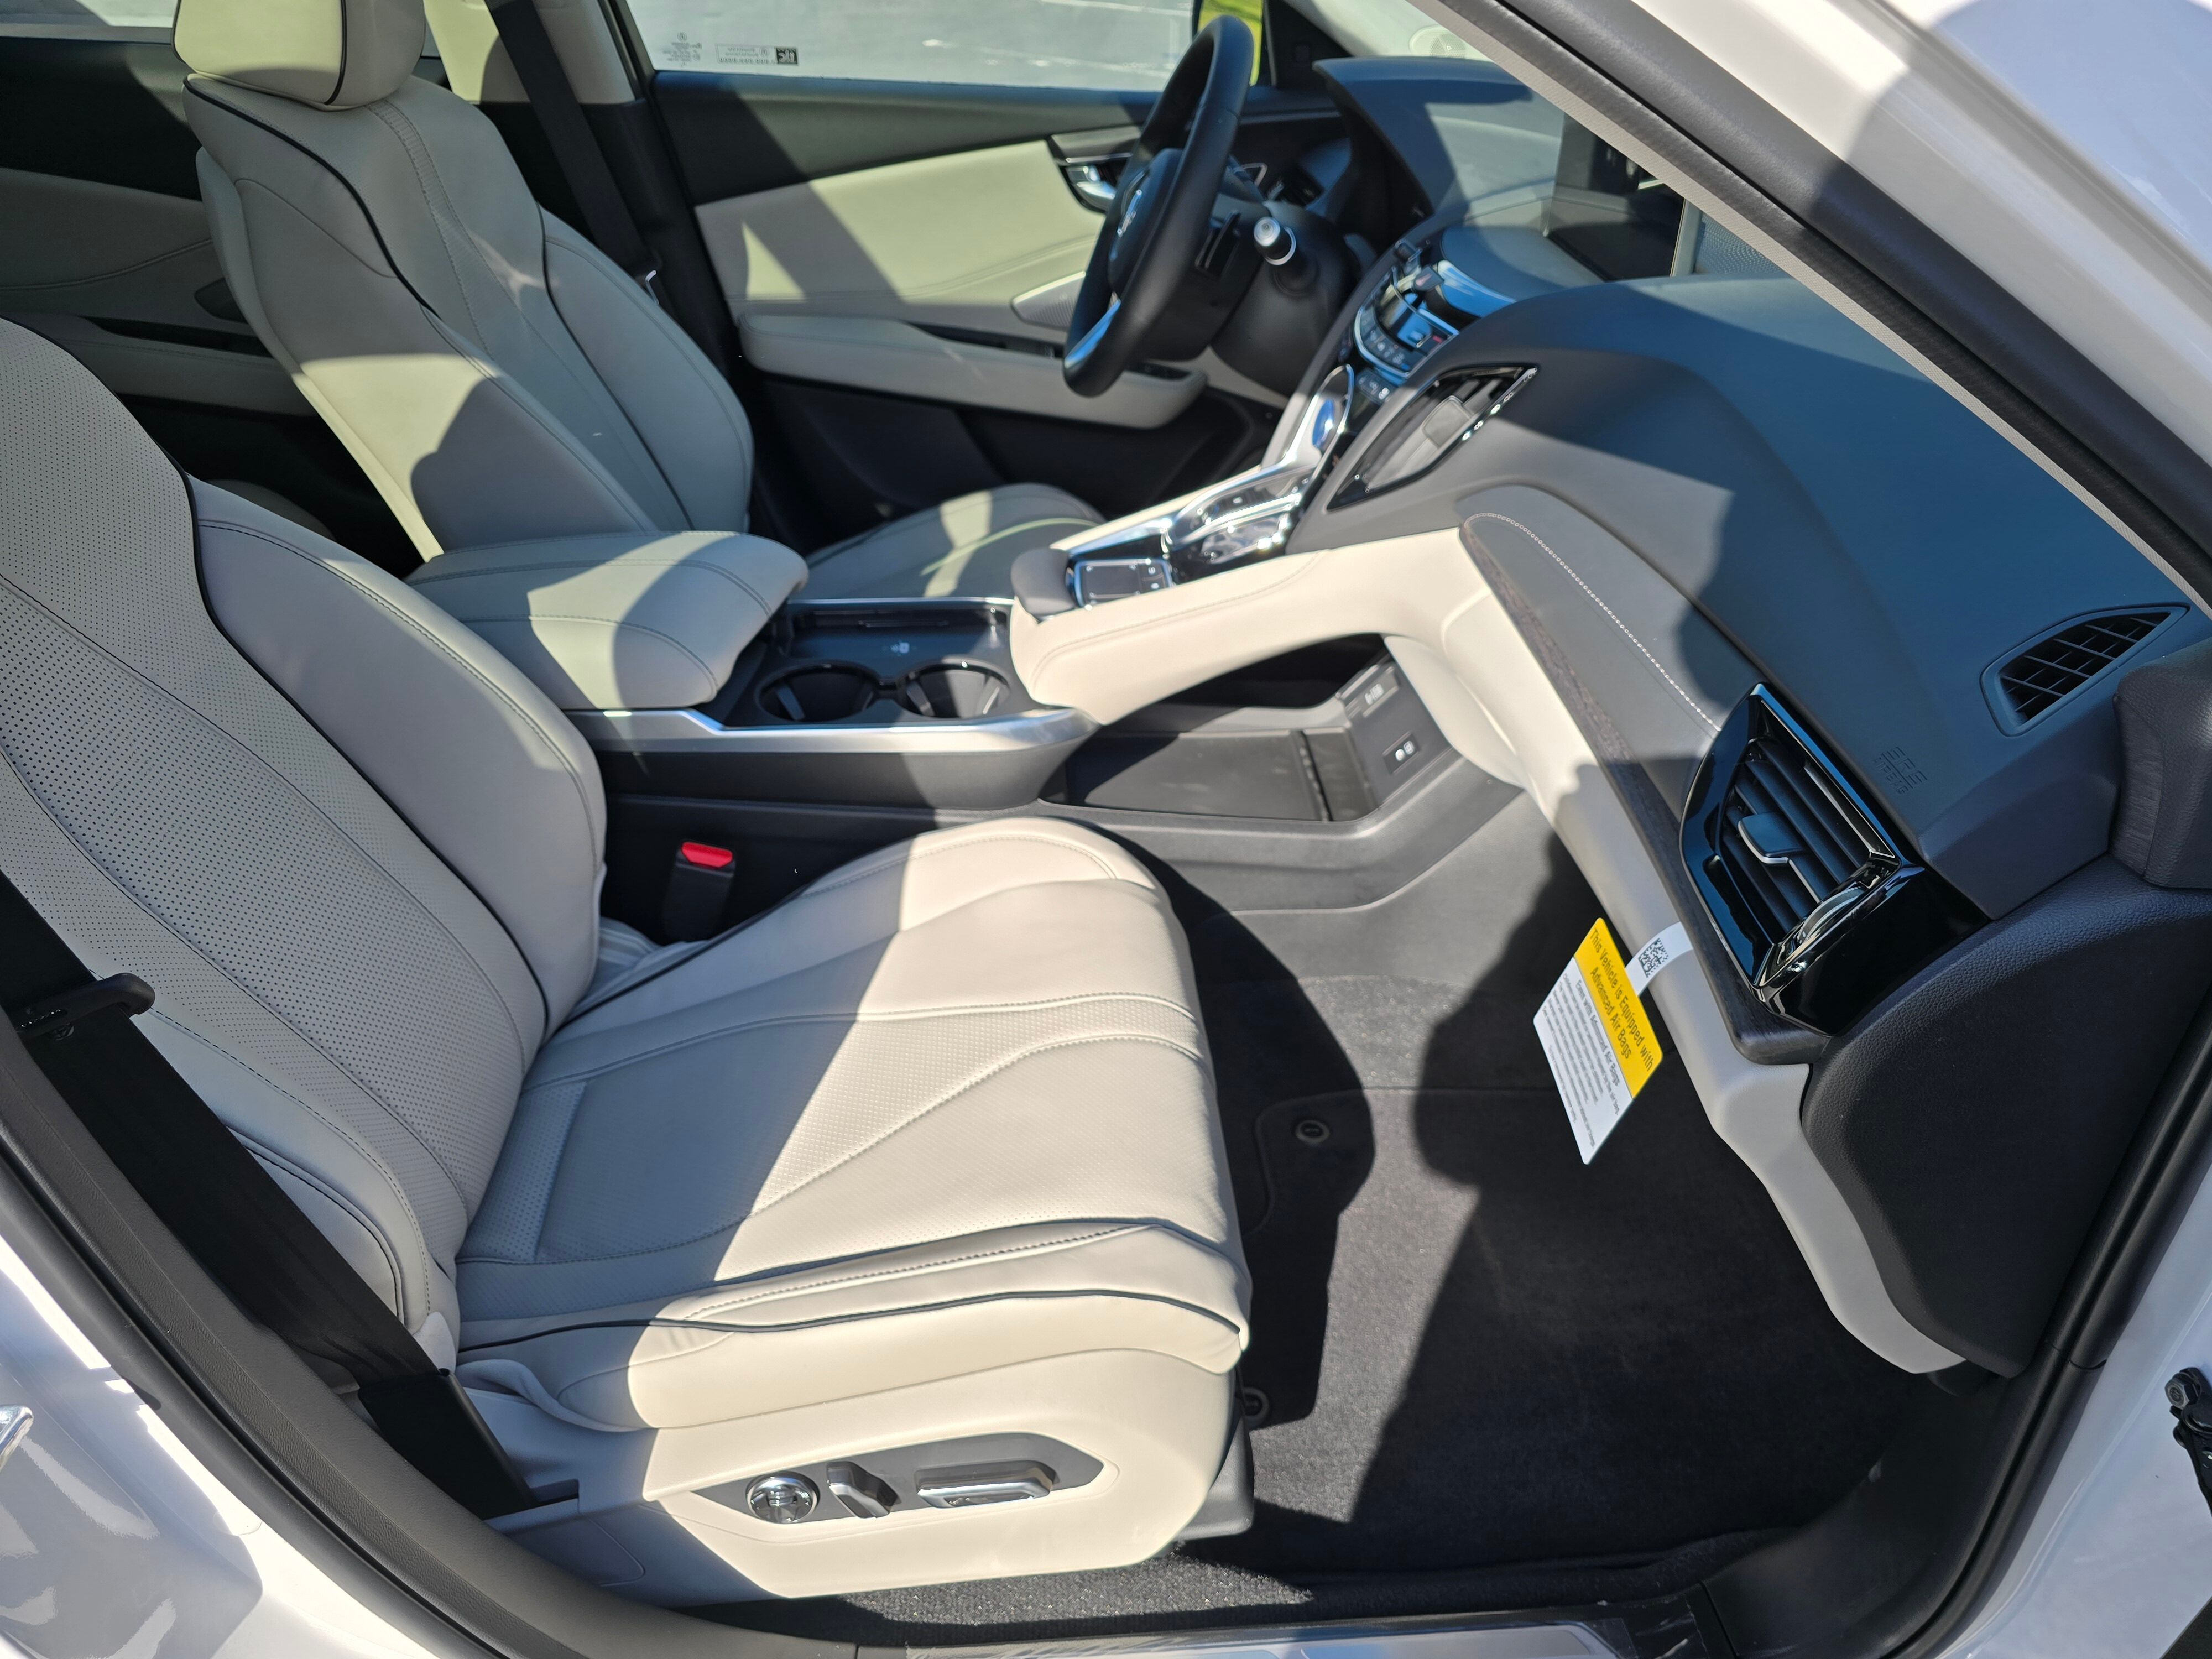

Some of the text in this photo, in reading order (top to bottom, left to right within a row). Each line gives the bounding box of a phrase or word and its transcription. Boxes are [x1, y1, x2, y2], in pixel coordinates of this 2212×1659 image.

[1886, 747, 1928, 784] SRS
[1589, 927, 1653, 1071] This Vehicle is Equipped with
[1590, 967, 1632, 1060] Advanced Air Bags
